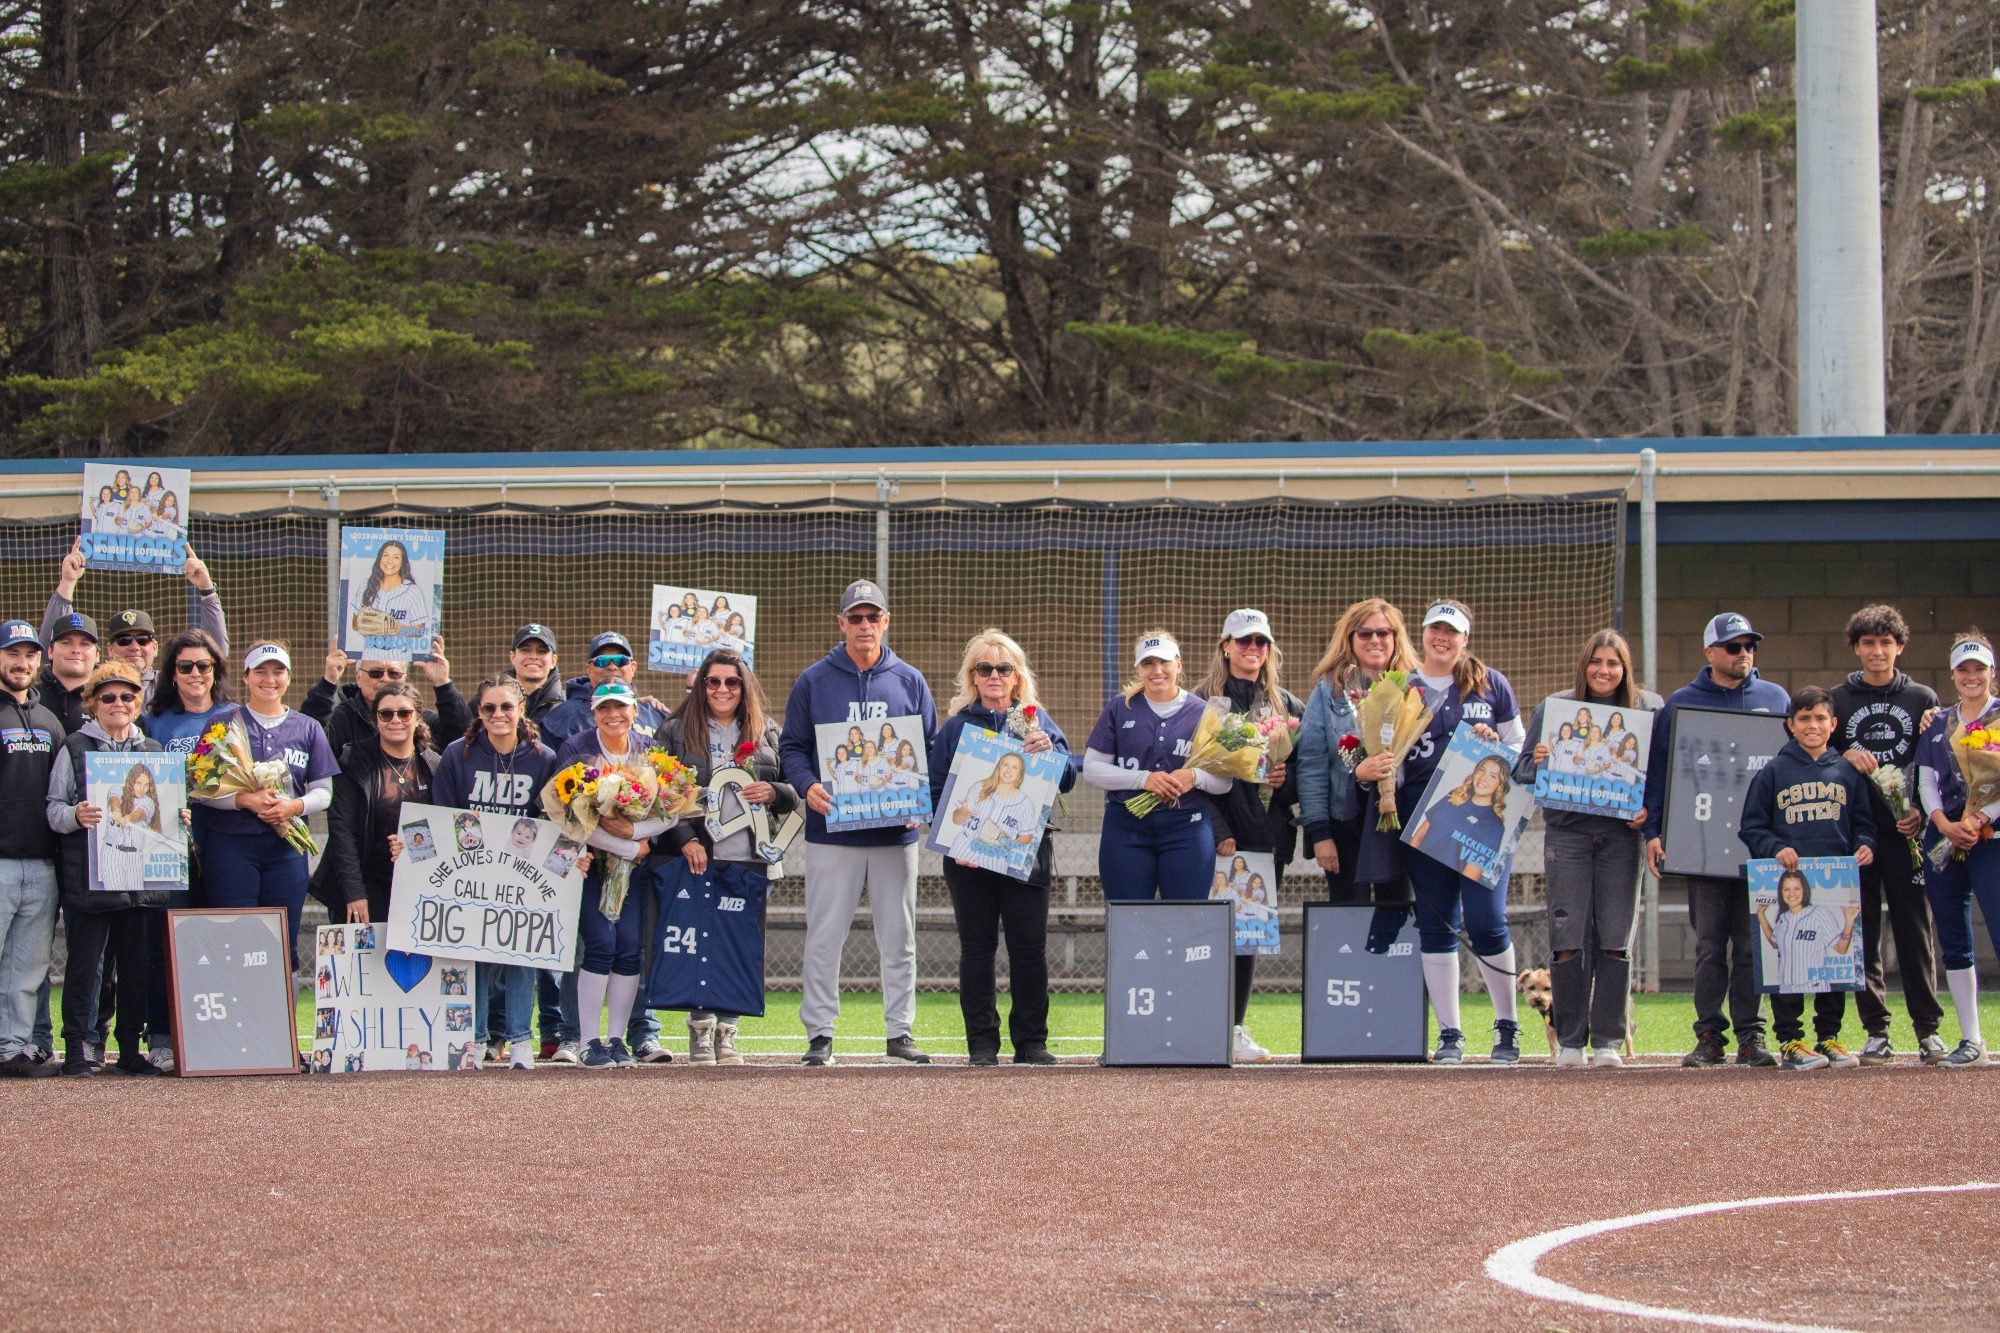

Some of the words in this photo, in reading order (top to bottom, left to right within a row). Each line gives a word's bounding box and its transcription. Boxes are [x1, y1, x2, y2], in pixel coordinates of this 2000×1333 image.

[80, 533, 187, 565] SENIORS
[341, 527, 445, 561] SEOR
[405, 535, 434, 543] SOFTBALL
[94, 545, 133, 555] WOMEN'S
[135, 547, 172, 558] SOFTBALL
[1439, 606, 1456, 616] MB
[9, 625, 34, 639] MB
[261, 646, 278, 654] MB
[1144, 638, 1160, 649] MB
[1963, 644, 1980, 653] MB
[846, 701, 889, 722] MB
[8, 740, 51, 754] patagonia
[1172, 738, 1194, 758] M
[115, 757, 145, 765] WOMEN'S
[146, 757, 175, 765] SOFTBALL
[283, 747, 310, 769] MB
[86, 752, 187, 785] SENOR
[468, 770, 534, 806] MB
[1534, 769, 1646, 812] SENIORS
[1550, 782, 1589, 797] WOMEN'S
[1591, 788, 1629, 803] SOFTBALL
[1777, 781, 1847, 810] CSUMB
[825, 785, 933, 824] SENIORS
[839, 803, 879, 815] WOMEN'S
[880, 799, 918, 810] SOFTBALL
[1694, 792, 1713, 822] 8
[149, 853, 179, 863] ALYSSA
[1460, 845, 1497, 875] VEGA
[1815, 862, 1848, 870] SOFTBALL
[144, 864, 179, 878] BURT
[429, 860, 454, 888] SHE
[452, 849, 493, 870] LOVES
[498, 851, 512, 865] IT
[512, 856, 543, 884] WHEN
[537, 879, 557, 903] WE
[454, 878, 489, 901] CALL
[495, 883, 526, 906] HER
[717, 895, 746, 912] MB
[420, 900, 466, 944] BIG
[481, 908, 556, 955] POPPA
[1235, 930, 1266, 939] FTBALL
[1796, 929, 1817, 941] MB
[663, 925, 697, 955] 24
[1387, 942, 1414, 957] MB
[242, 951, 268, 967] MB
[1184, 945, 1212, 962] MB
[330, 952, 373, 998] WE
[1807, 966, 1854, 981] PEREZ
[1127, 987, 1156, 1016] 13
[1326, 979, 1361, 1007] 55
[193, 992, 227, 1022] 35
[332, 1006, 441, 1052] ASHLEY
